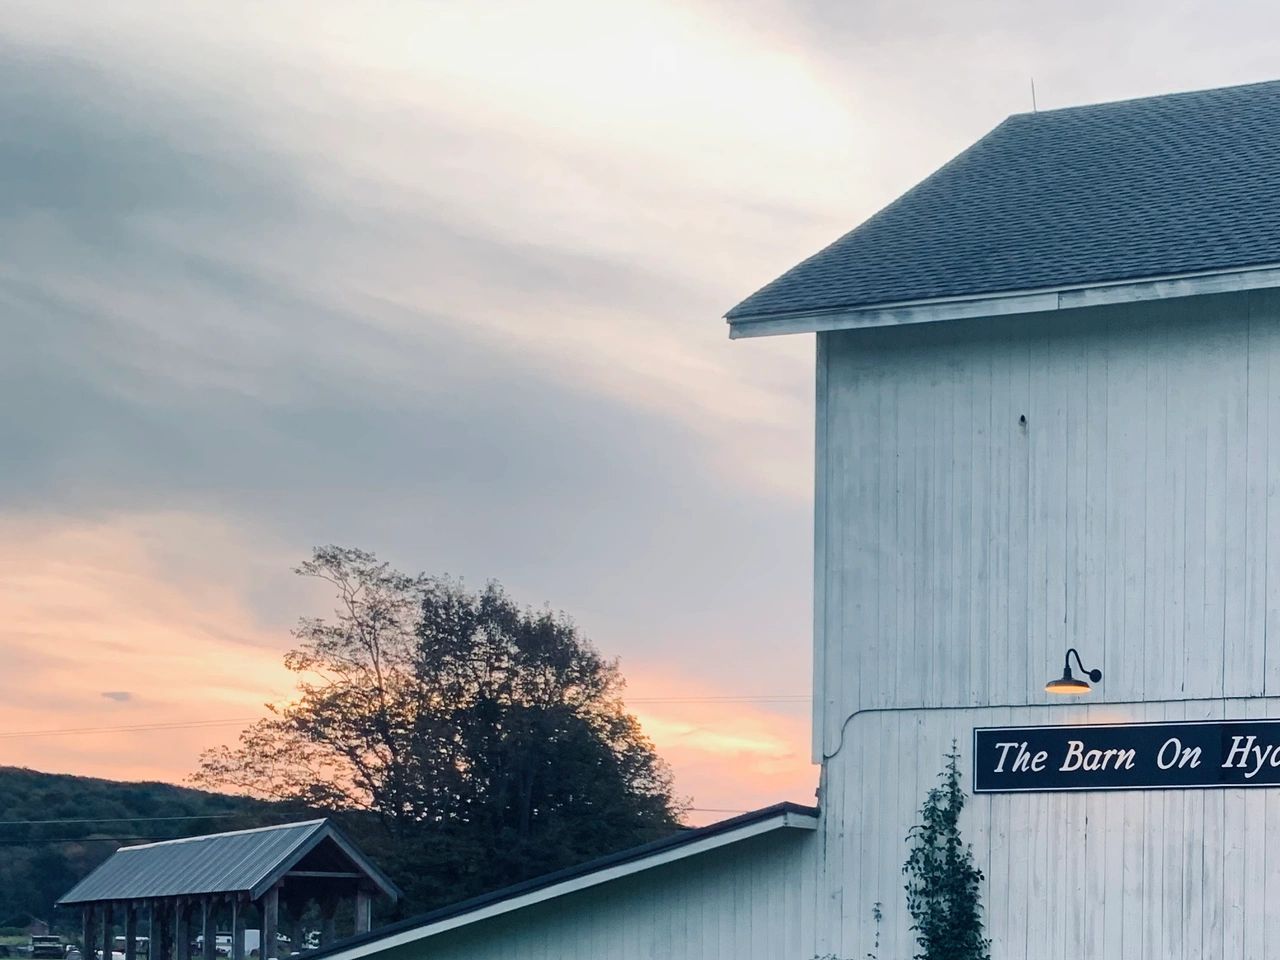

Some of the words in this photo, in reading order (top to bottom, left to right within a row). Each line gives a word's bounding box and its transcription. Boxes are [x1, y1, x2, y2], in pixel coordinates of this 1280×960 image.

[993, 741, 1047, 772] The
[1059, 740, 1135, 772] Barn
[1156, 737, 1202, 769] On
